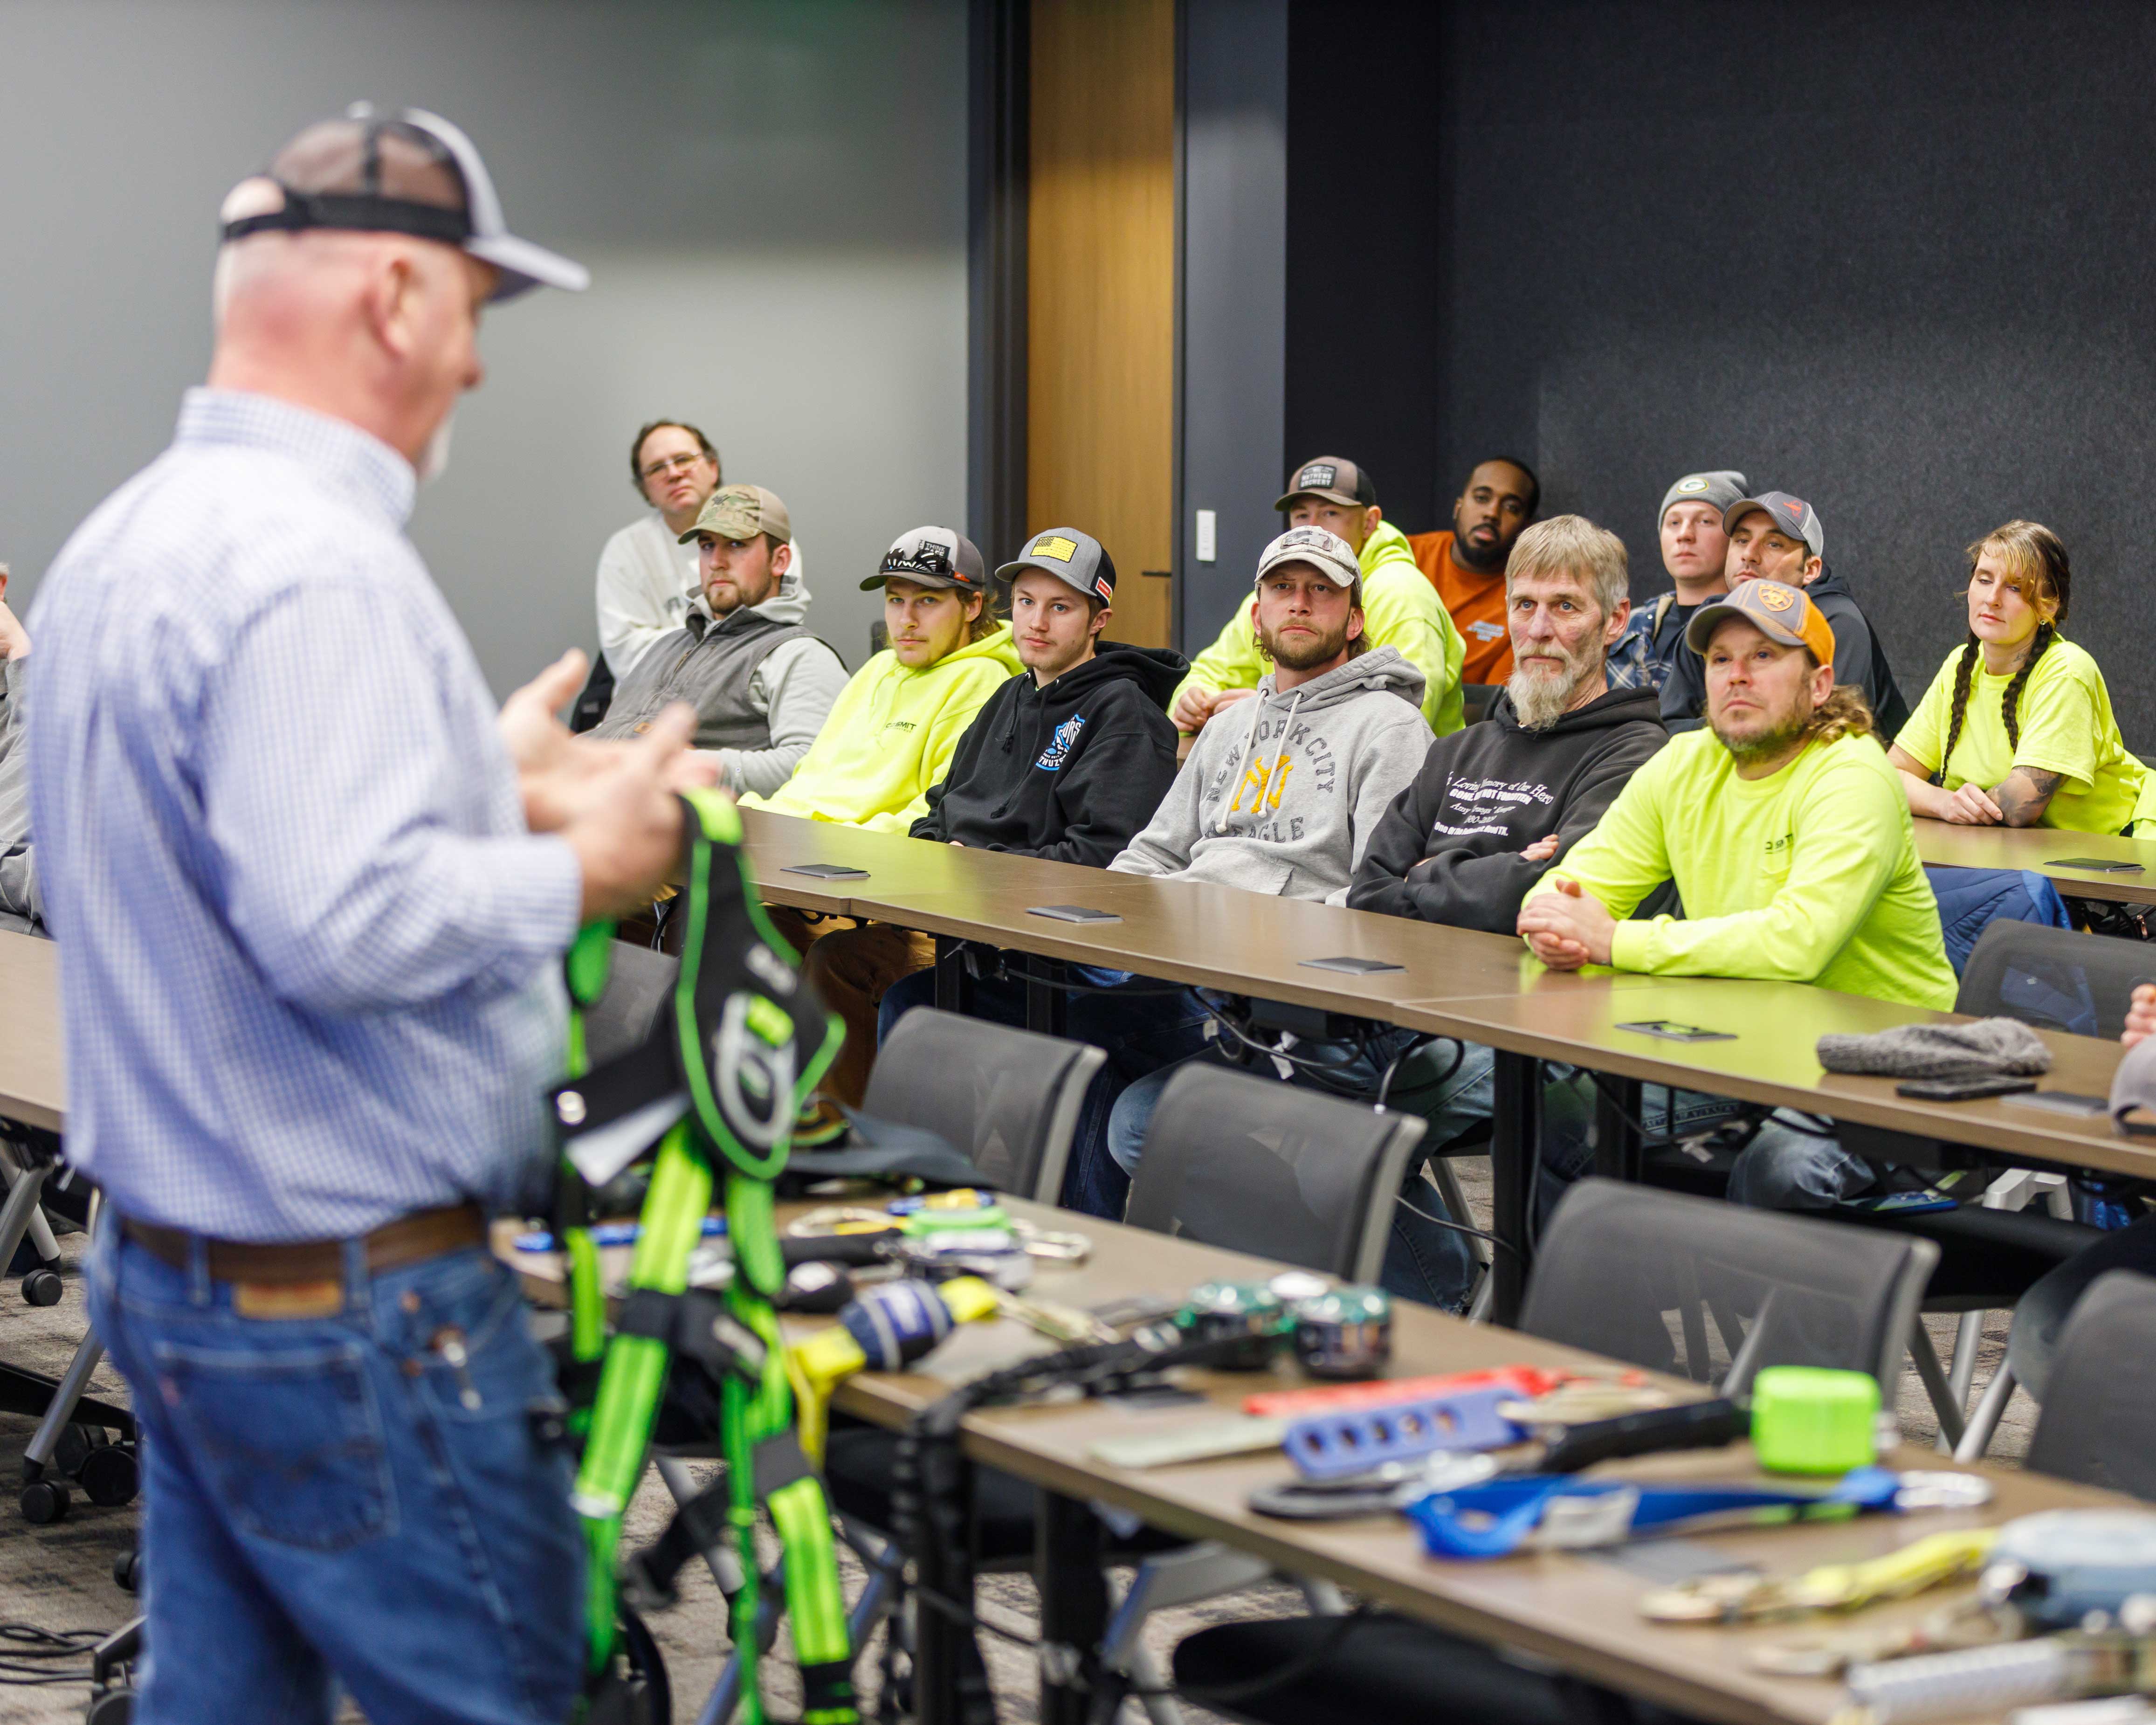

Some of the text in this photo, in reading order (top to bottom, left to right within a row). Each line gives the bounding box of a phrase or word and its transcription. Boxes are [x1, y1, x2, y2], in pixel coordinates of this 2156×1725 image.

[926, 543, 946, 552] THINK
[1305, 738, 1335, 794] CITY
[1529, 784, 1554, 805] Hero
[1434, 821, 1449, 834] One
